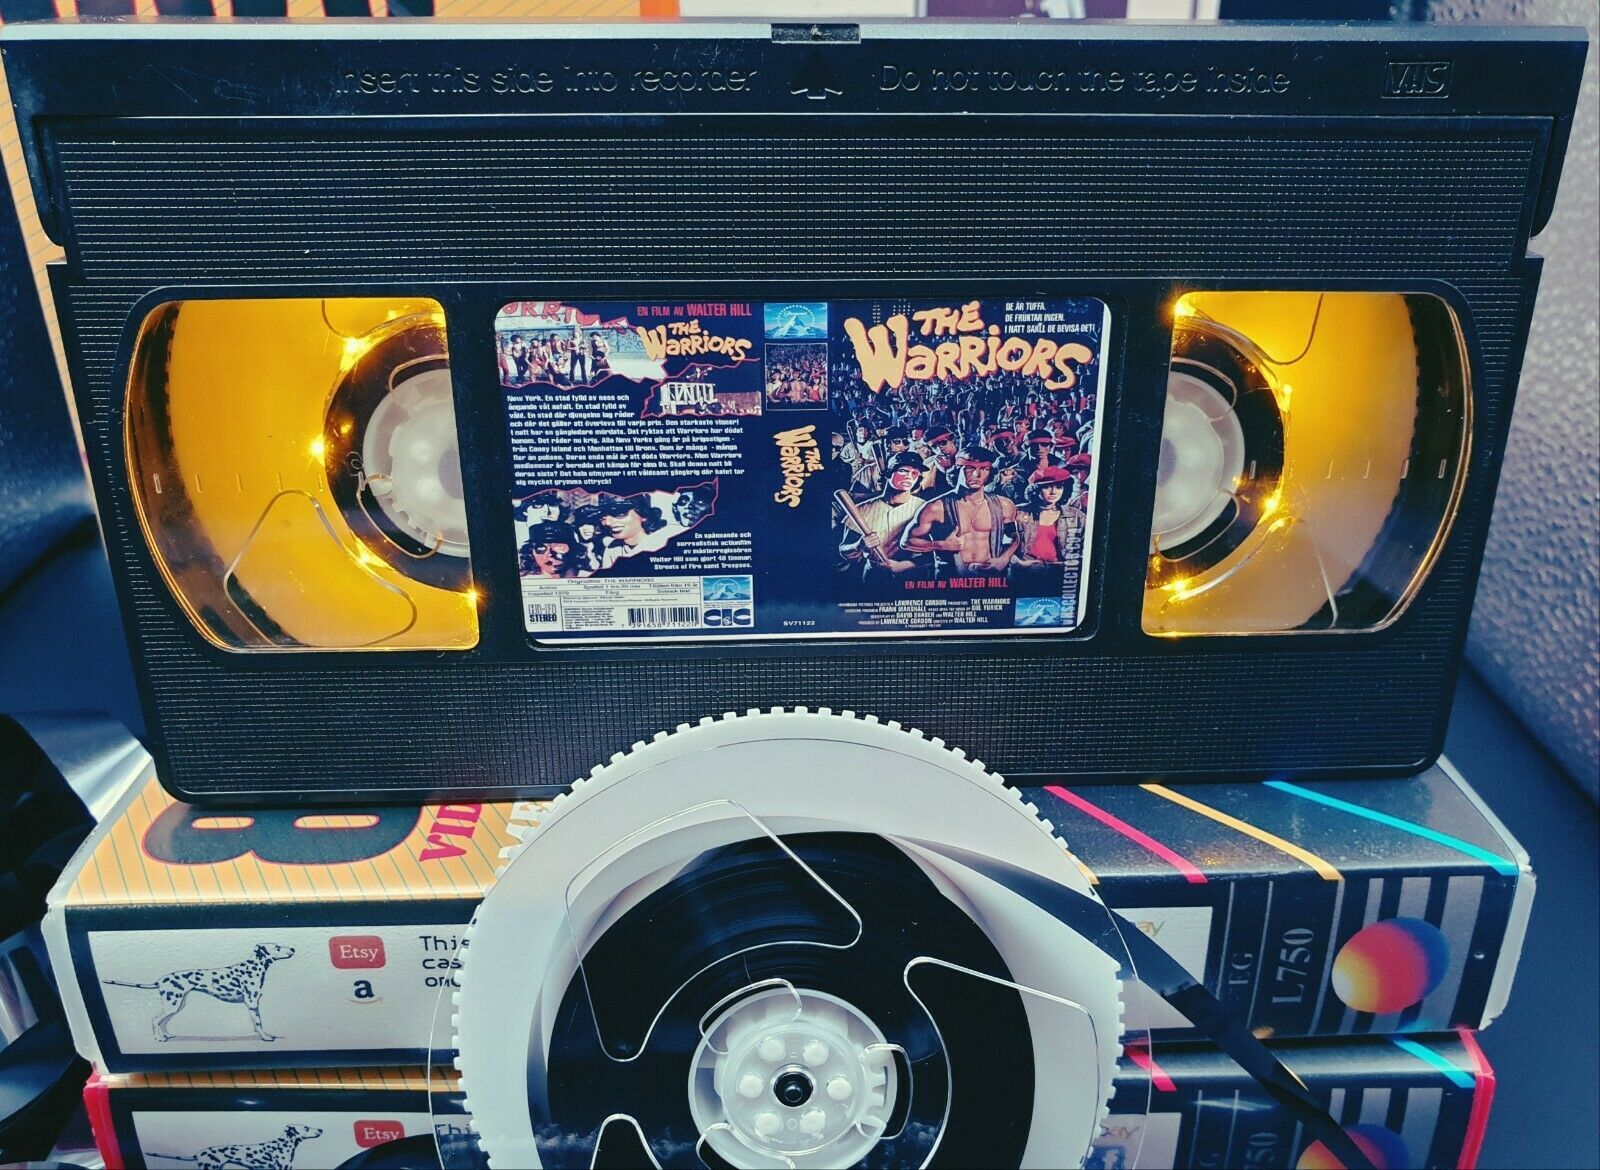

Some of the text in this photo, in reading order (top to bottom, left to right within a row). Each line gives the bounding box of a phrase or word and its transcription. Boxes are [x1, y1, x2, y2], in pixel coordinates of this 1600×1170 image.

[879, 65, 920, 91] Do
[1392, 64, 1448, 94] VHS
[687, 303, 726, 316] WALTER
[730, 303, 752, 316] HILL
[1006, 302, 1014, 311] DE
[1026, 302, 1046, 311] TUFFA.
[913, 300, 984, 335] THE
[1005, 314, 1014, 322] DE
[668, 319, 701, 336] THE
[1008, 325, 1025, 333] NATT
[1047, 324, 1056, 333] DE
[1057, 324, 1079, 333] BEVISA
[804, 446, 824, 472] THE
[917, 580, 934, 589] FILM
[949, 577, 985, 589] WALTER
[988, 577, 1008, 588] HILL
[529, 614, 557, 623] STEREO
[339, 944, 379, 962] Etsy
[1272, 928, 1314, 1003] L750
[353, 979, 375, 999] a
[363, 1127, 400, 1141] Etsy
